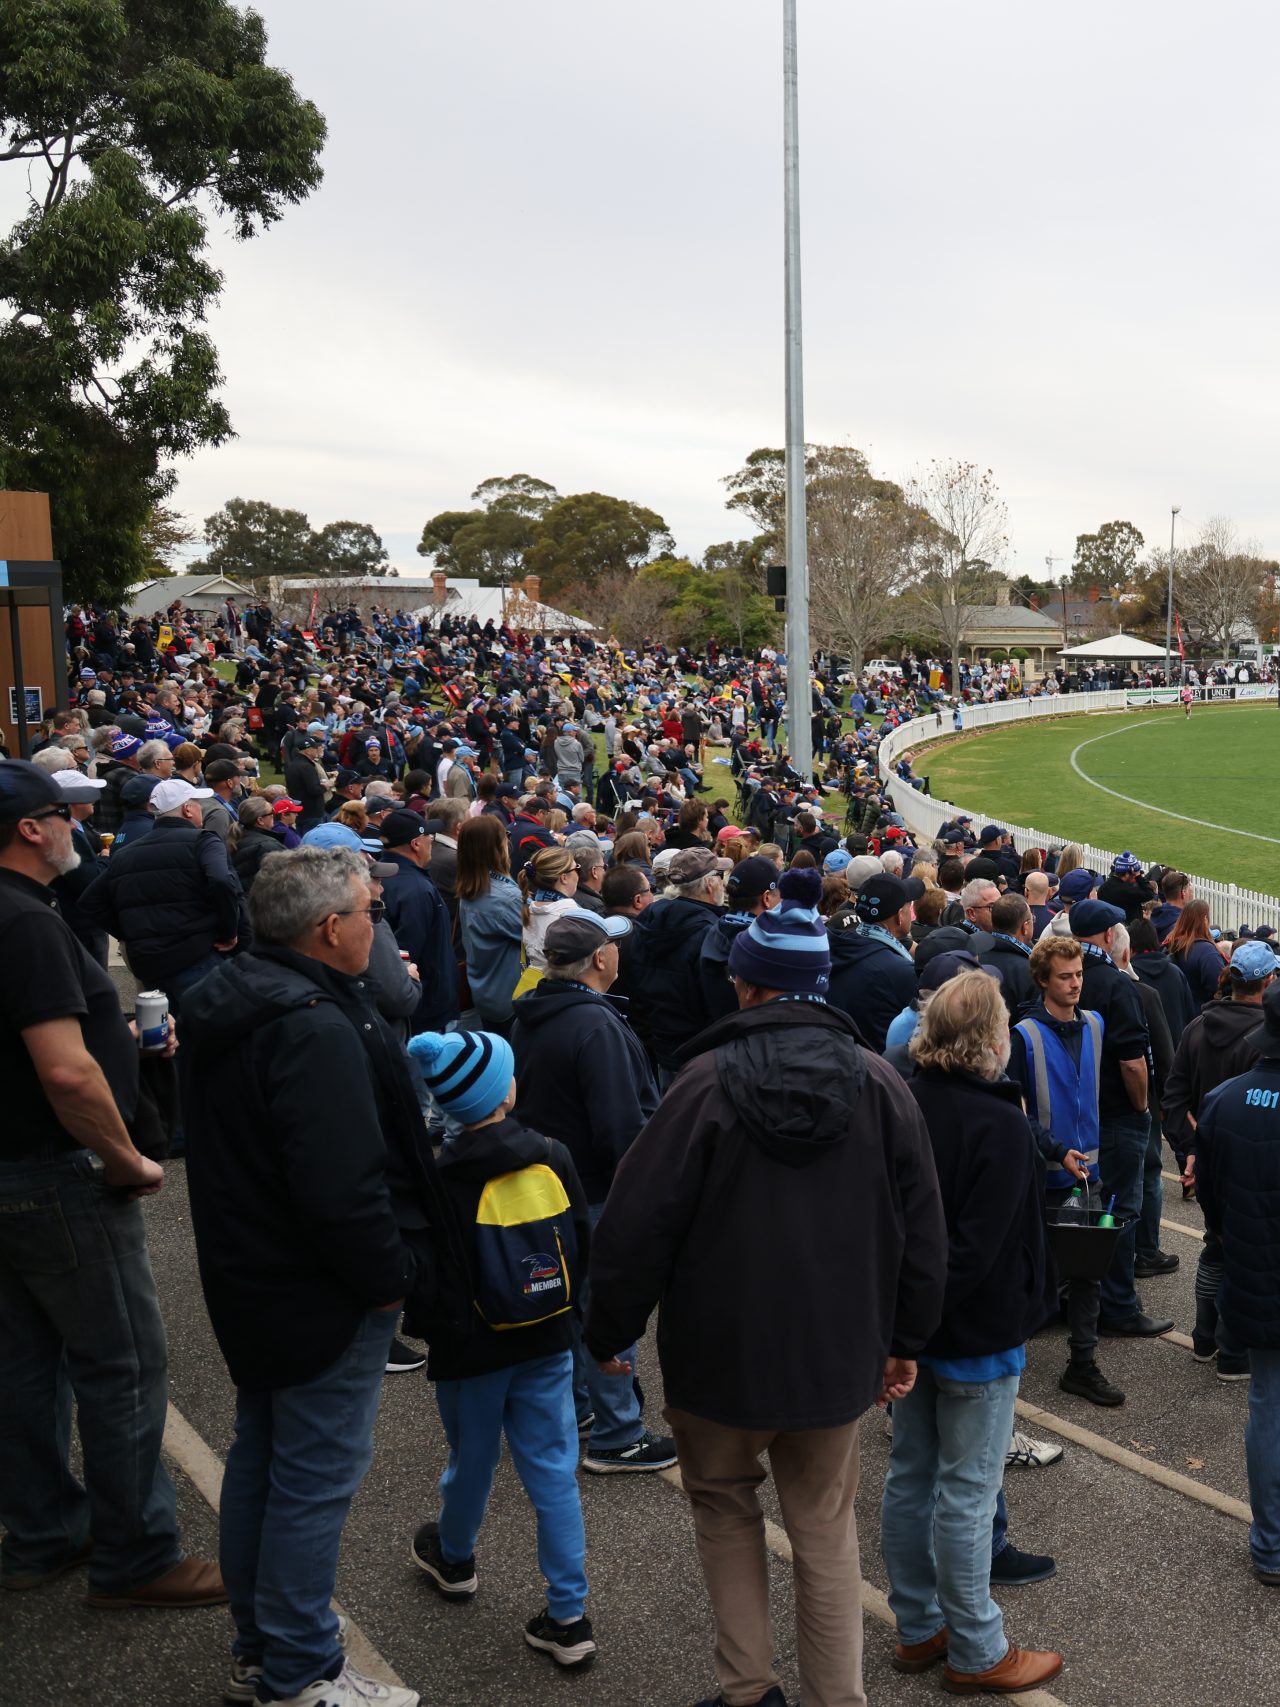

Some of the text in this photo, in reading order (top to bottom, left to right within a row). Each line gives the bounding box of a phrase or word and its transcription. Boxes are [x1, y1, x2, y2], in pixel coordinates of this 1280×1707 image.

[1211, 688, 1231, 697] UNLEY
[1245, 1088, 1280, 1109] 1901
[531, 1278, 562, 1293] MEMBER
